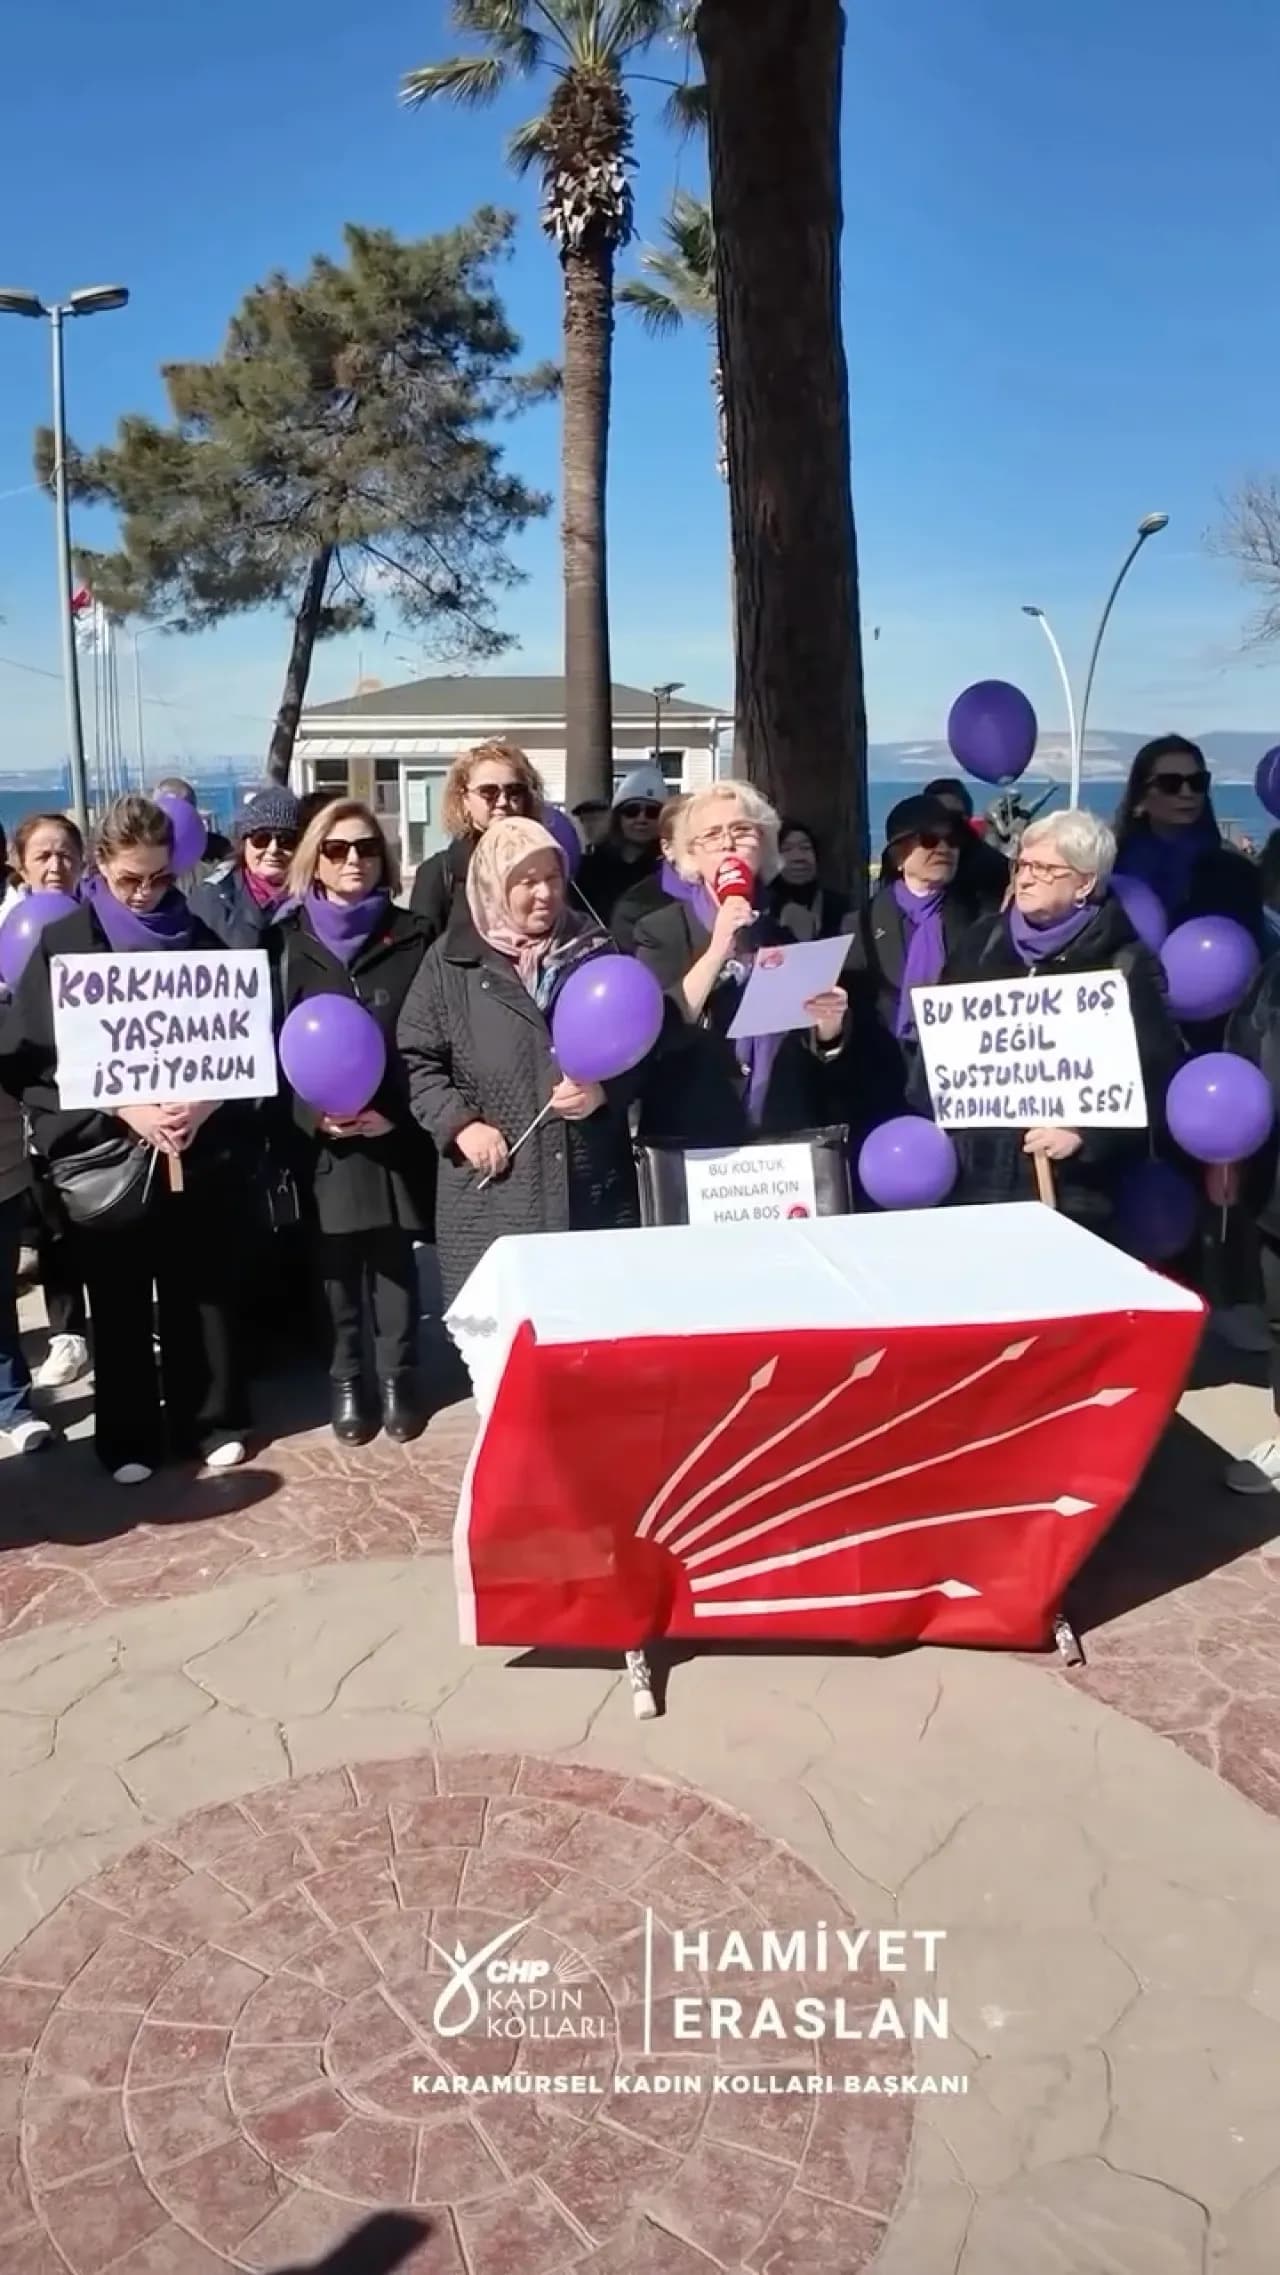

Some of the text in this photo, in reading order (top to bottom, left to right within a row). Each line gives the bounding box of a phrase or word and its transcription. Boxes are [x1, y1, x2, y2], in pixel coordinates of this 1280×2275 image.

[56, 962, 259, 1009] KORKMADAN
[923, 980, 1117, 1026] BU KOLTUK BOŞ
[100, 1008, 250, 1054] YAŞAMAK
[979, 1022, 1056, 1054] DEĞİL
[935, 1057, 1094, 1090] SUSTURULAN
[936, 1081, 1134, 1121] KADINLARIN SESİ
[708, 1158, 784, 1176] BU KOLTUK
[701, 1182, 769, 1200] KADINLAR
[713, 1208, 750, 1223] HALA
